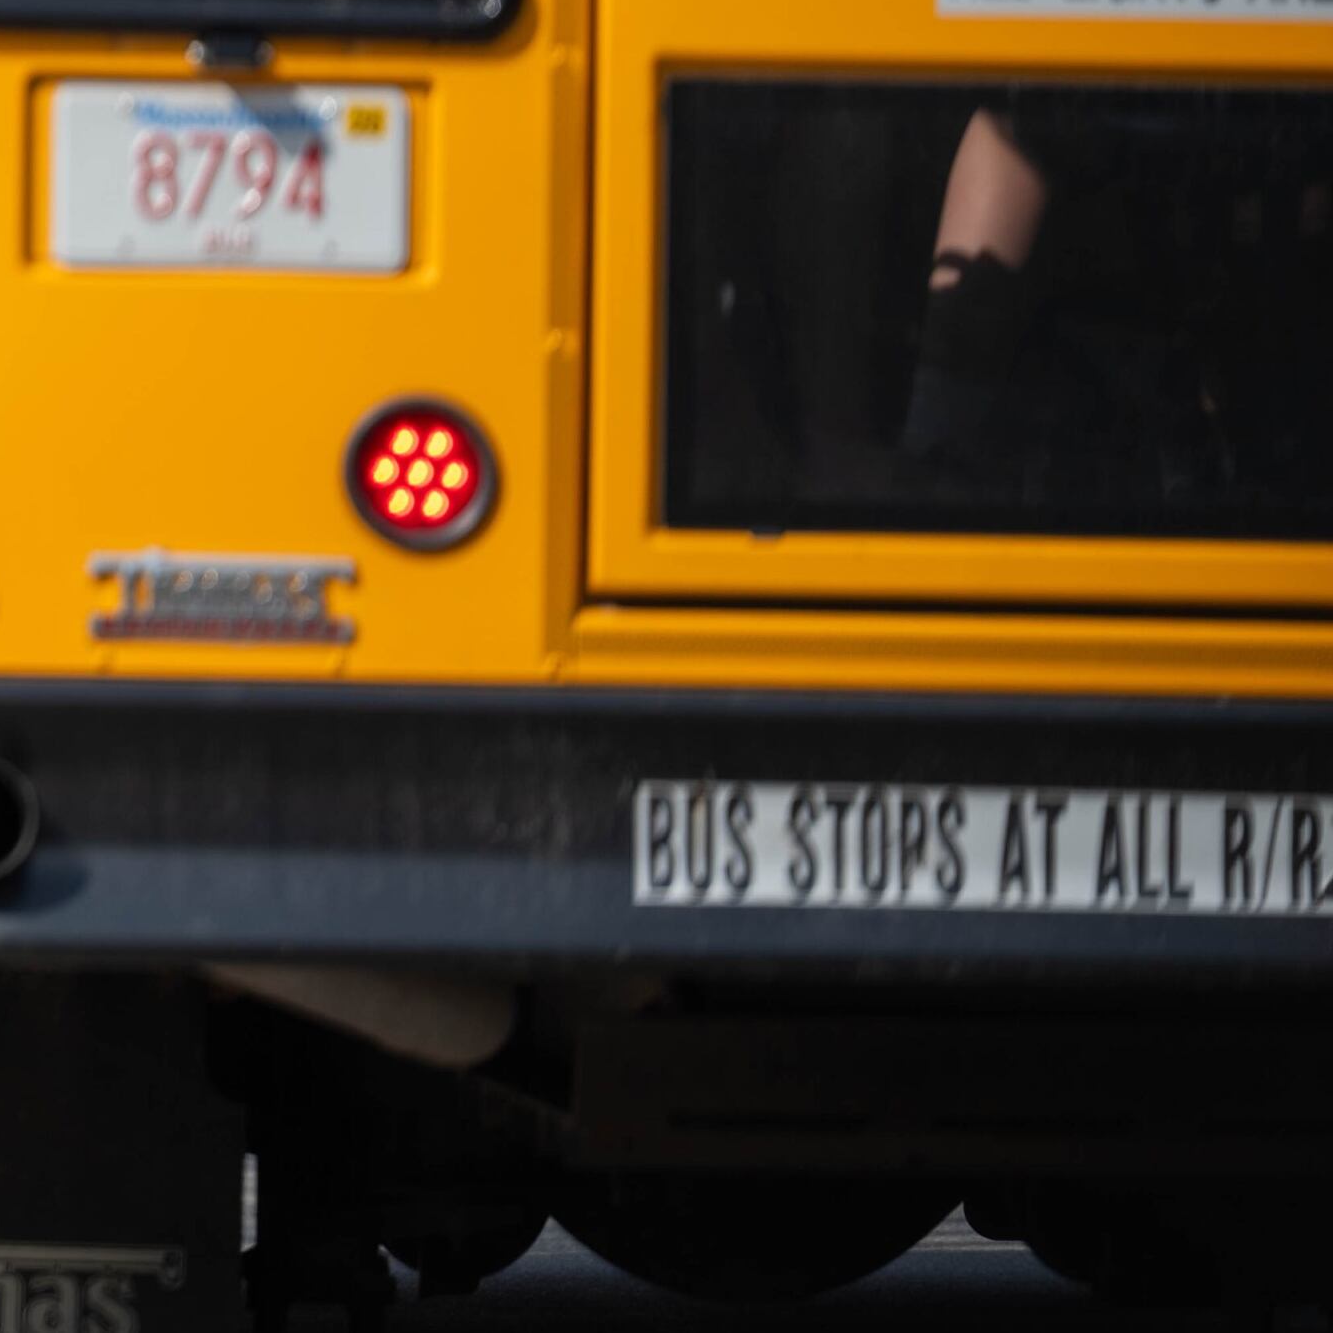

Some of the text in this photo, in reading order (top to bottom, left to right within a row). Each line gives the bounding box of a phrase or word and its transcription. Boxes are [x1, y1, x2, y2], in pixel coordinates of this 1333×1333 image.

[134, 131, 326, 222] 8794
[645, 785, 1333, 907] BUS STOPS AT ALL R/R
